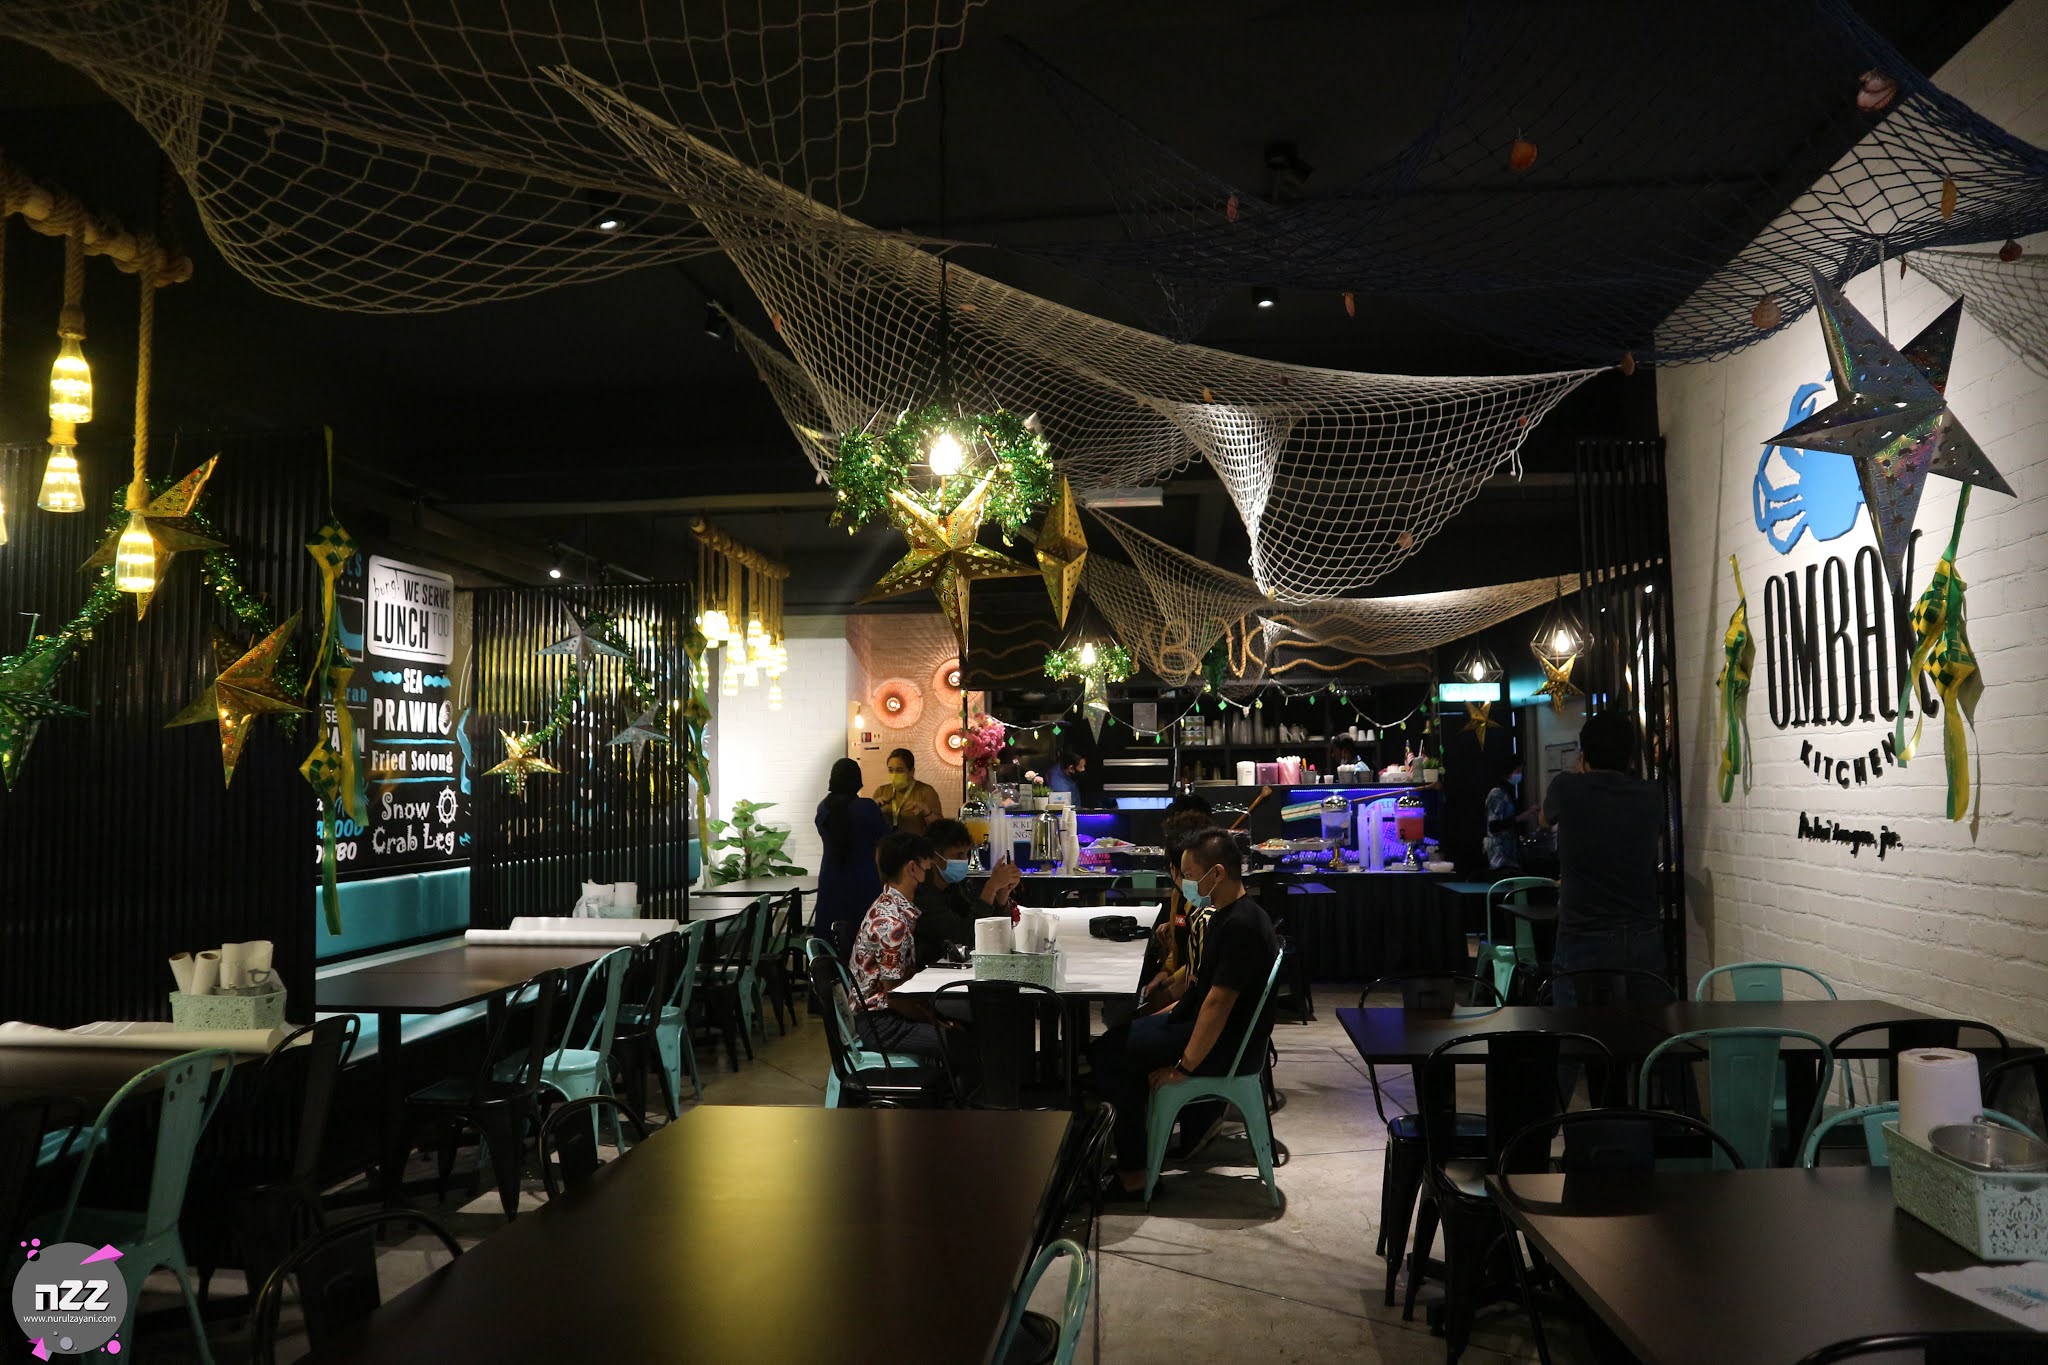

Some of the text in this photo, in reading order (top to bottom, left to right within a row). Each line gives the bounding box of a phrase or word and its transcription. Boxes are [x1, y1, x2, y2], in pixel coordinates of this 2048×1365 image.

[403, 579, 420, 603] WE
[422, 583, 451, 610] SERVE
[373, 600, 450, 649] LUNCH TOO
[1764, 529, 1939, 730] OMBAK
[403, 668, 423, 694] SEA
[373, 698, 438, 733] PRAWN
[371, 750, 453, 773] Fried Sotong
[1800, 732, 1898, 788] KITCHEN
[382, 792, 430, 820] Snow
[372, 823, 455, 855] Crab Leg
